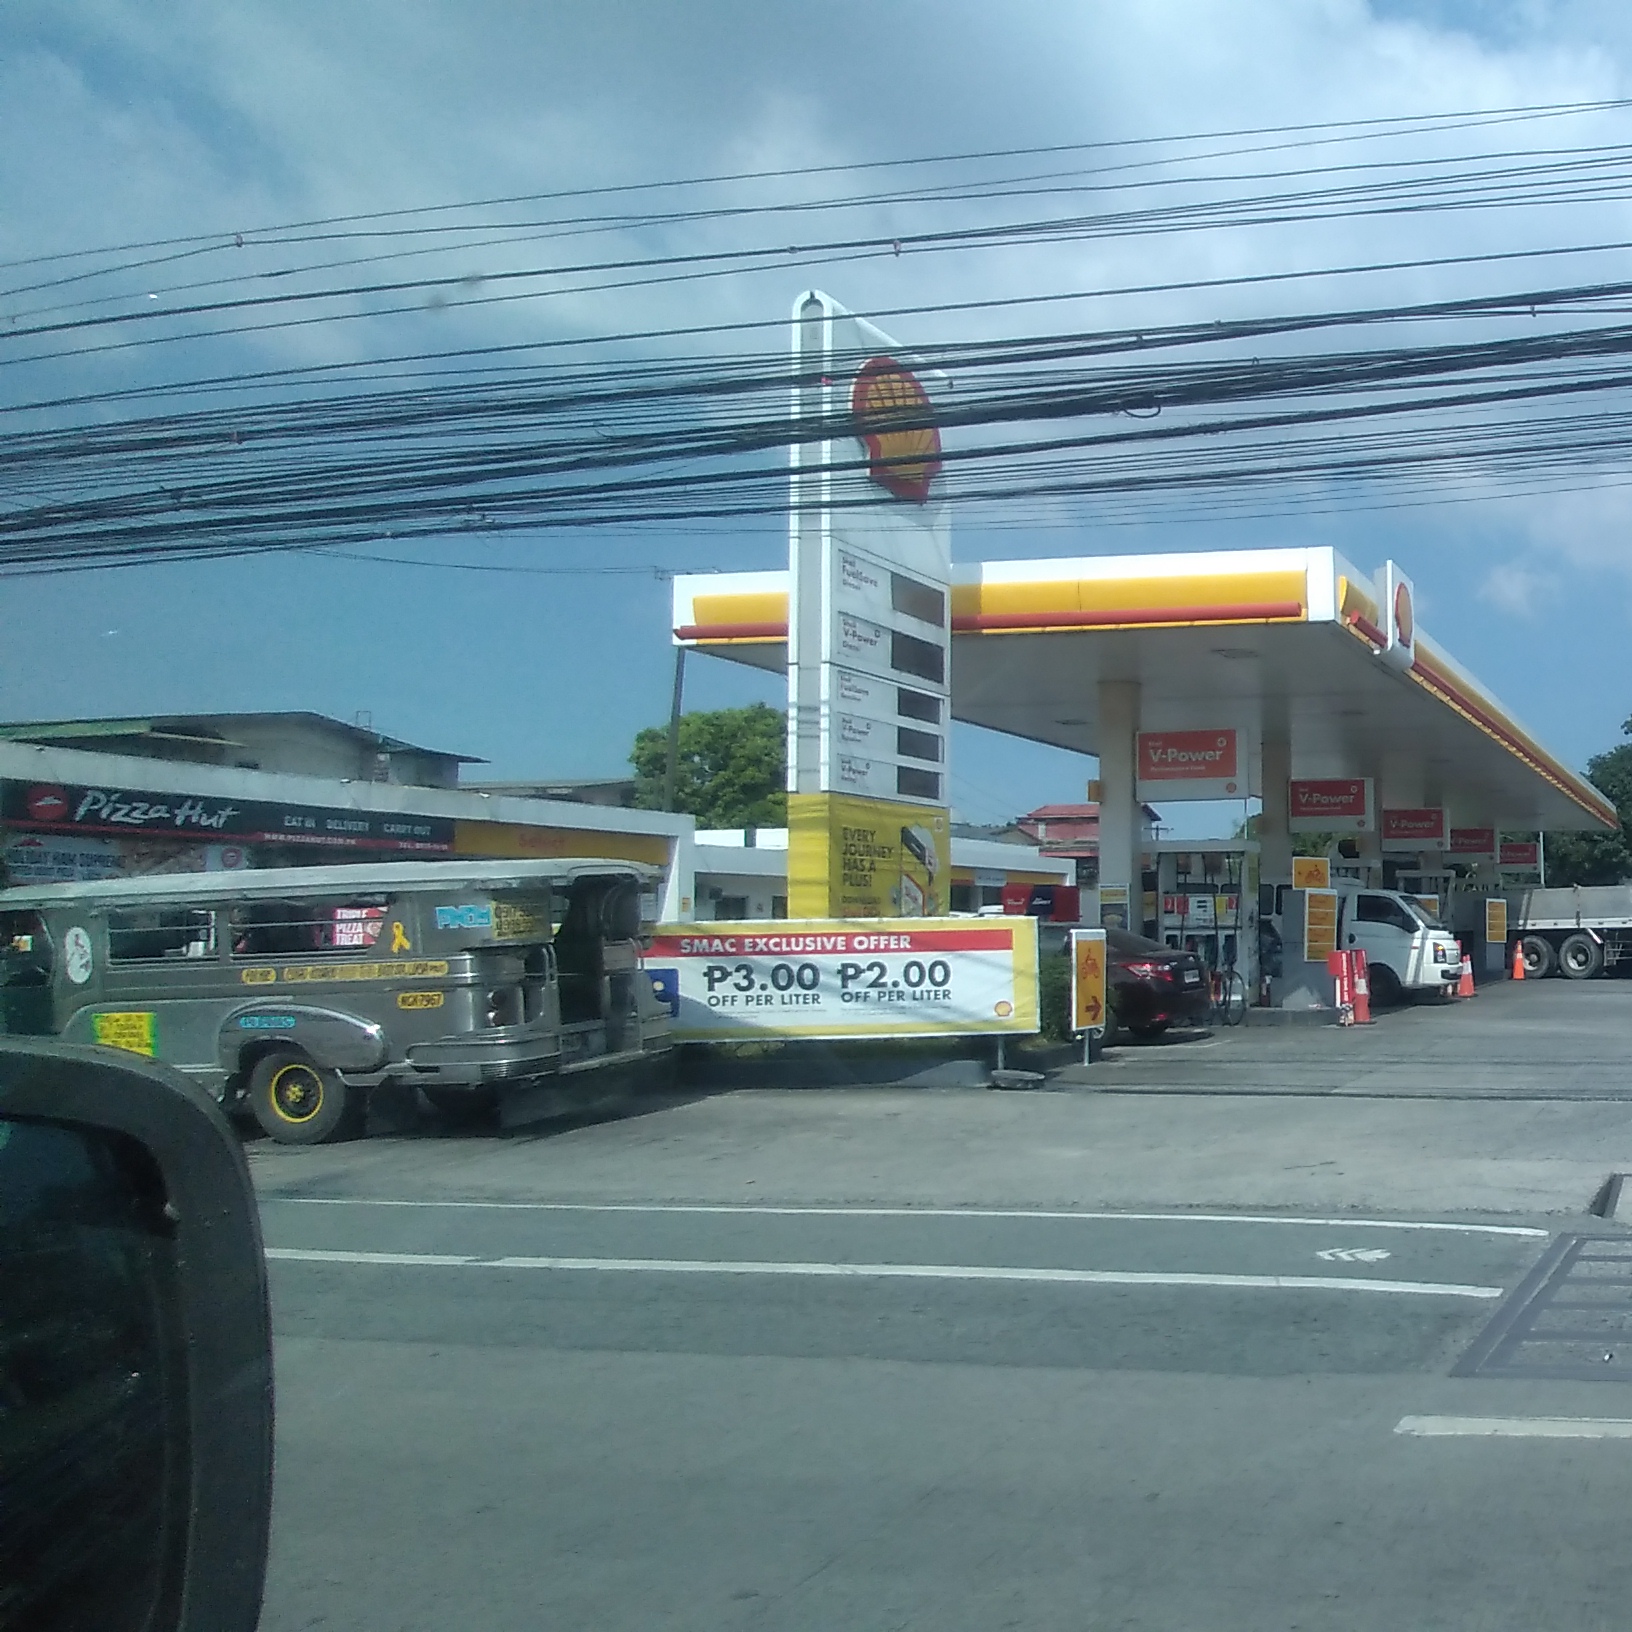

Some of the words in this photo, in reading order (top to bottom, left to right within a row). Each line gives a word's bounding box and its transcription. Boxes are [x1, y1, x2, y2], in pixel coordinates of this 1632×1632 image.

[843, 628, 877, 646] V-Power
[1150, 748, 1223, 762] V-Power
[1299, 793, 1355, 804] V-Power
[75, 789, 170, 824] Pizza
[174, 799, 241, 828] Hut
[1390, 820, 1435, 829] V-Power
[842, 827, 877, 842] EVERY
[842, 843, 894, 859] JOURNEY
[842, 857, 866, 873] HAS
[867, 859, 877, 873] A
[842, 872, 872, 888] PLUS!
[336, 922, 364, 933] PIZZA
[336, 933, 365, 945] TREAT
[680, 938, 737, 953] SMAC
[744, 936, 846, 952] EXCLUSIVE
[853, 935, 911, 950] OFFER
[707, 994, 738, 1007] OFF
[745, 993, 774, 1006] PER
[781, 992, 821, 1005] LITER
[841, 991, 871, 1003] OFF
[878, 989, 906, 1002] PER
[912, 988, 952, 1001] LITER
